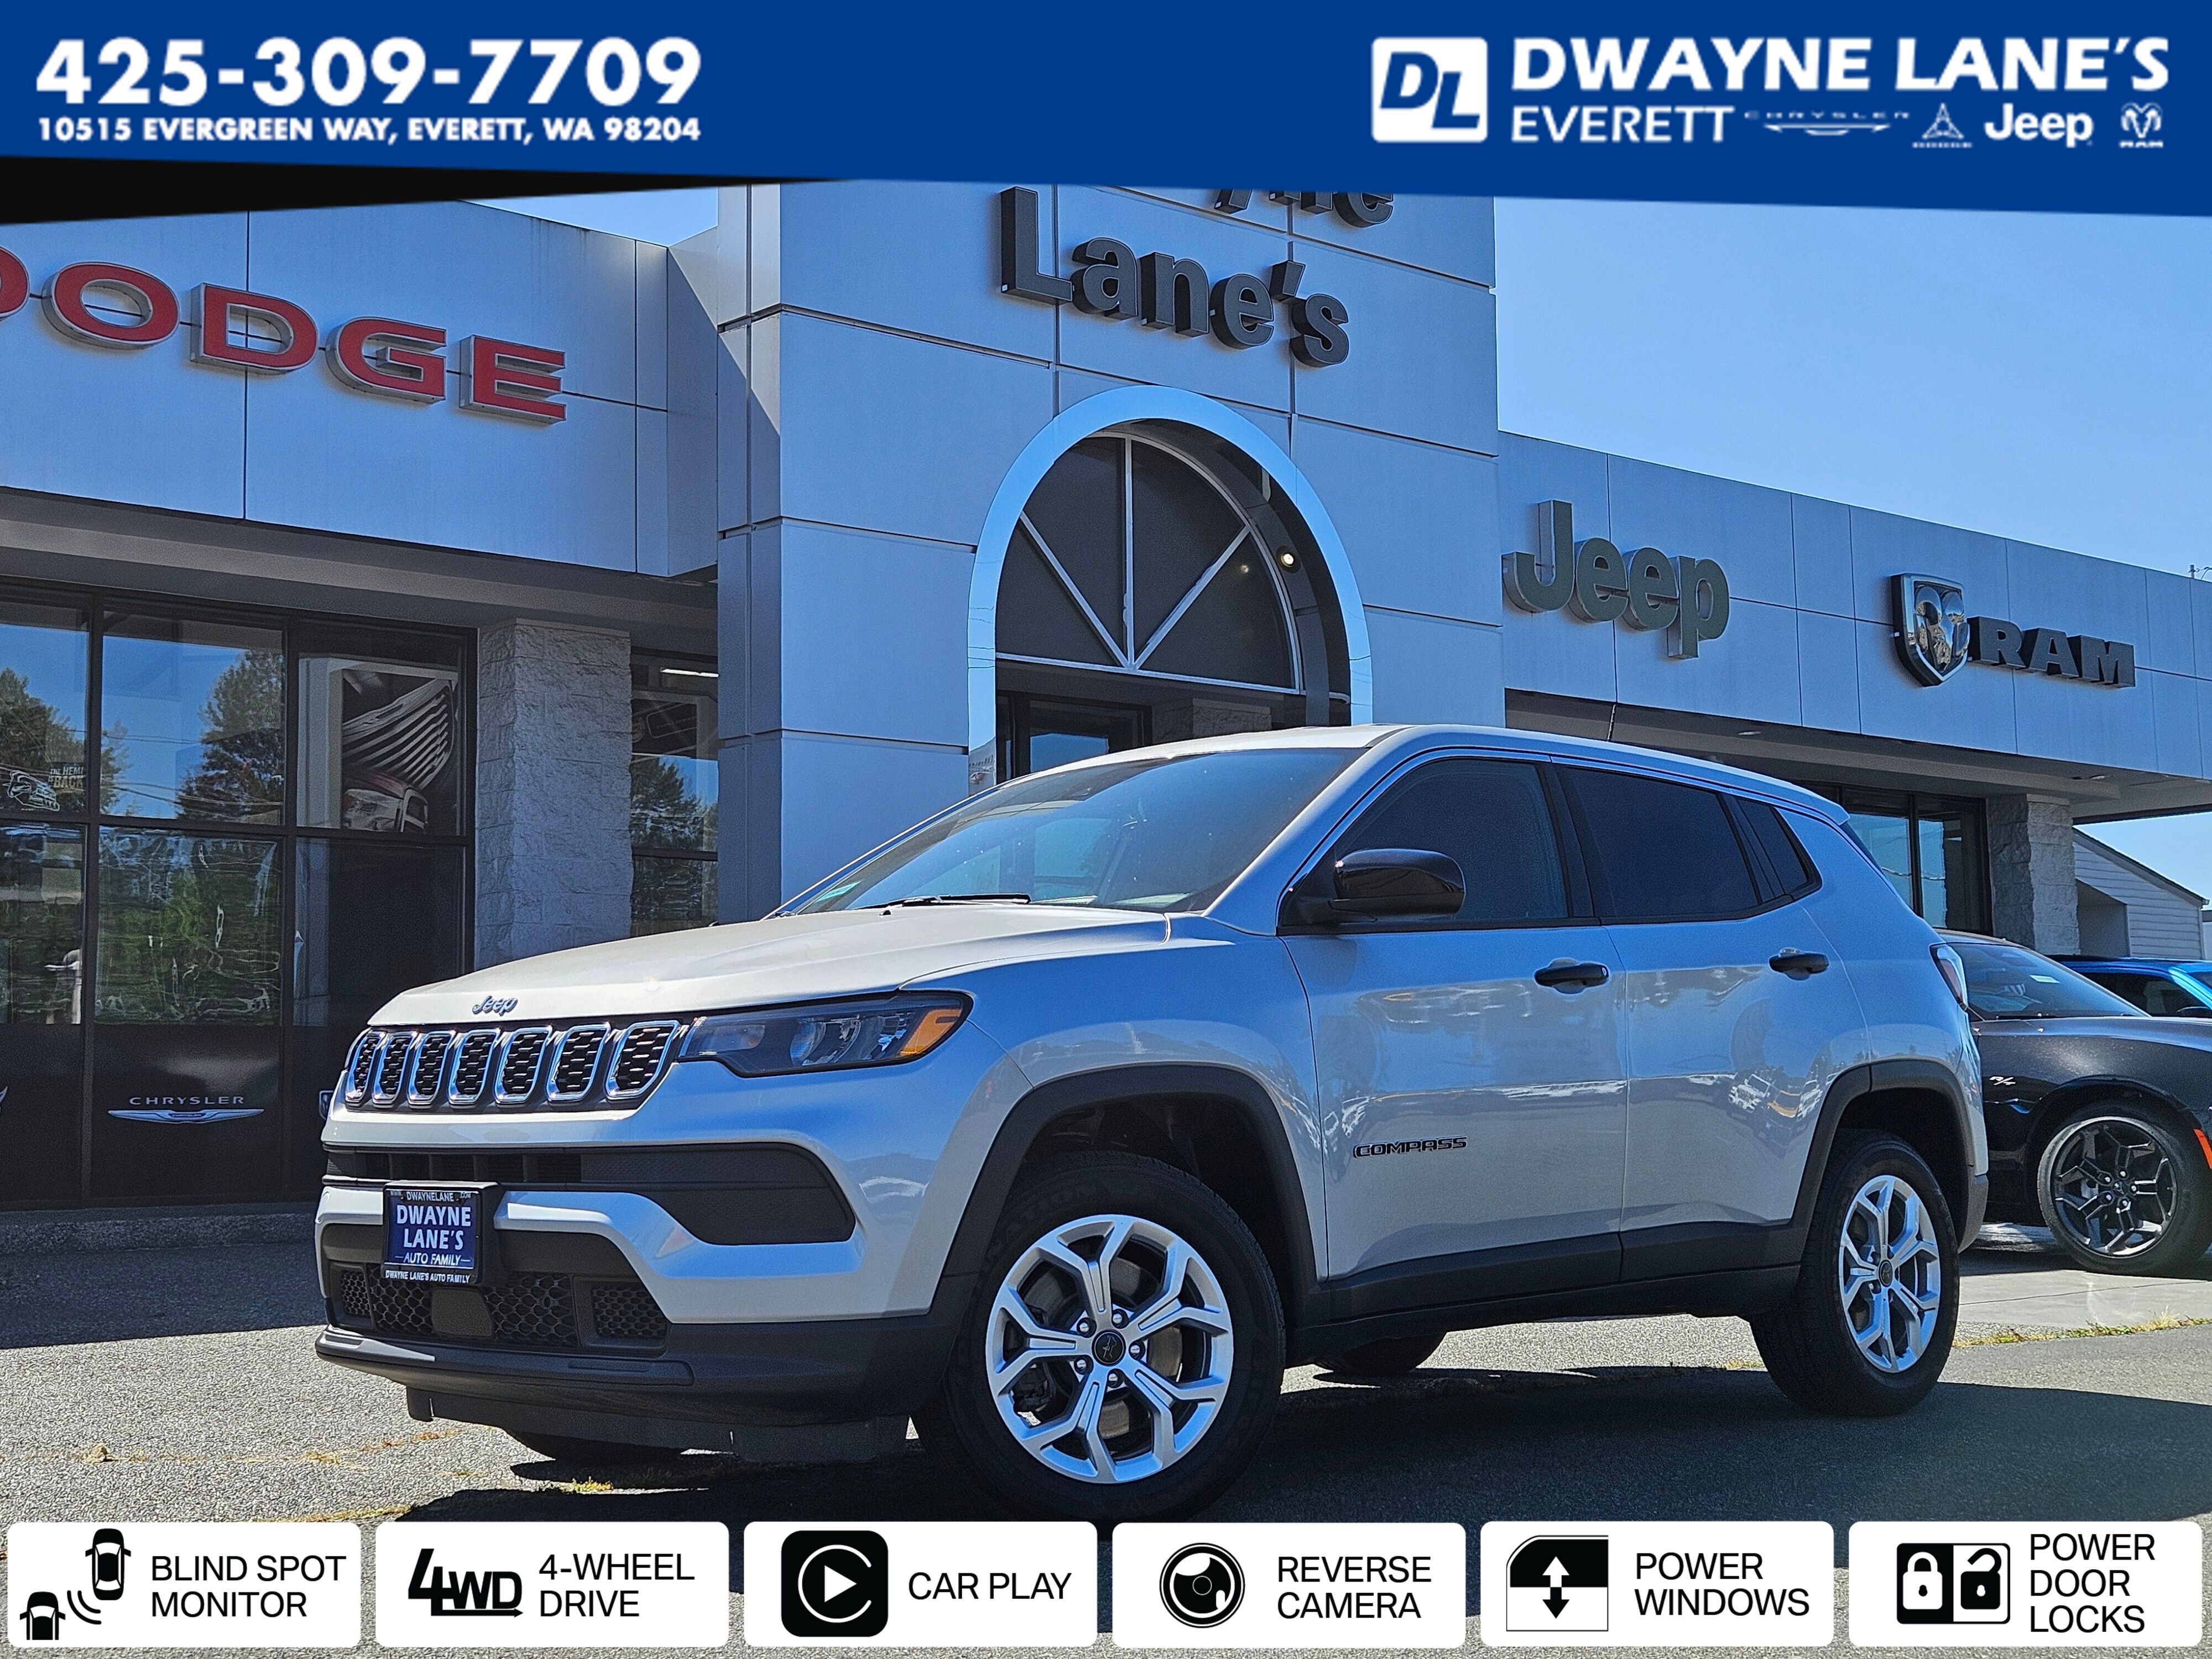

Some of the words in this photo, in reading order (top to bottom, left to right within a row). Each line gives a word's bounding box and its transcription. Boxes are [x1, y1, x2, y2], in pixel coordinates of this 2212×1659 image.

[1000, 186, 1349, 367] Lane's
[0, 247, 566, 424] ODGE
[1501, 499, 1730, 660] Jeep
[1967, 616, 2136, 688] RAM
[62, 766, 84, 775] HEMI
[54, 775, 84, 788] BACK
[472, 995, 518, 1016] Jeep
[129, 1095, 244, 1105] CHRYSLER
[1353, 1136, 1467, 1158] COMPASS
[406, 1191, 455, 1202] DWAYNELANE
[397, 1204, 471, 1227] DWAYNE
[403, 1228, 464, 1250] LANE'S
[403, 1252, 429, 1264] AUTO
[430, 1253, 462, 1266] FAMILY
[385, 1270, 409, 1280] DWAYNE
[409, 1271, 429, 1281] LANE'S
[430, 1273, 446, 1282] AUTO
[446, 1274, 471, 1284] FAMILY
